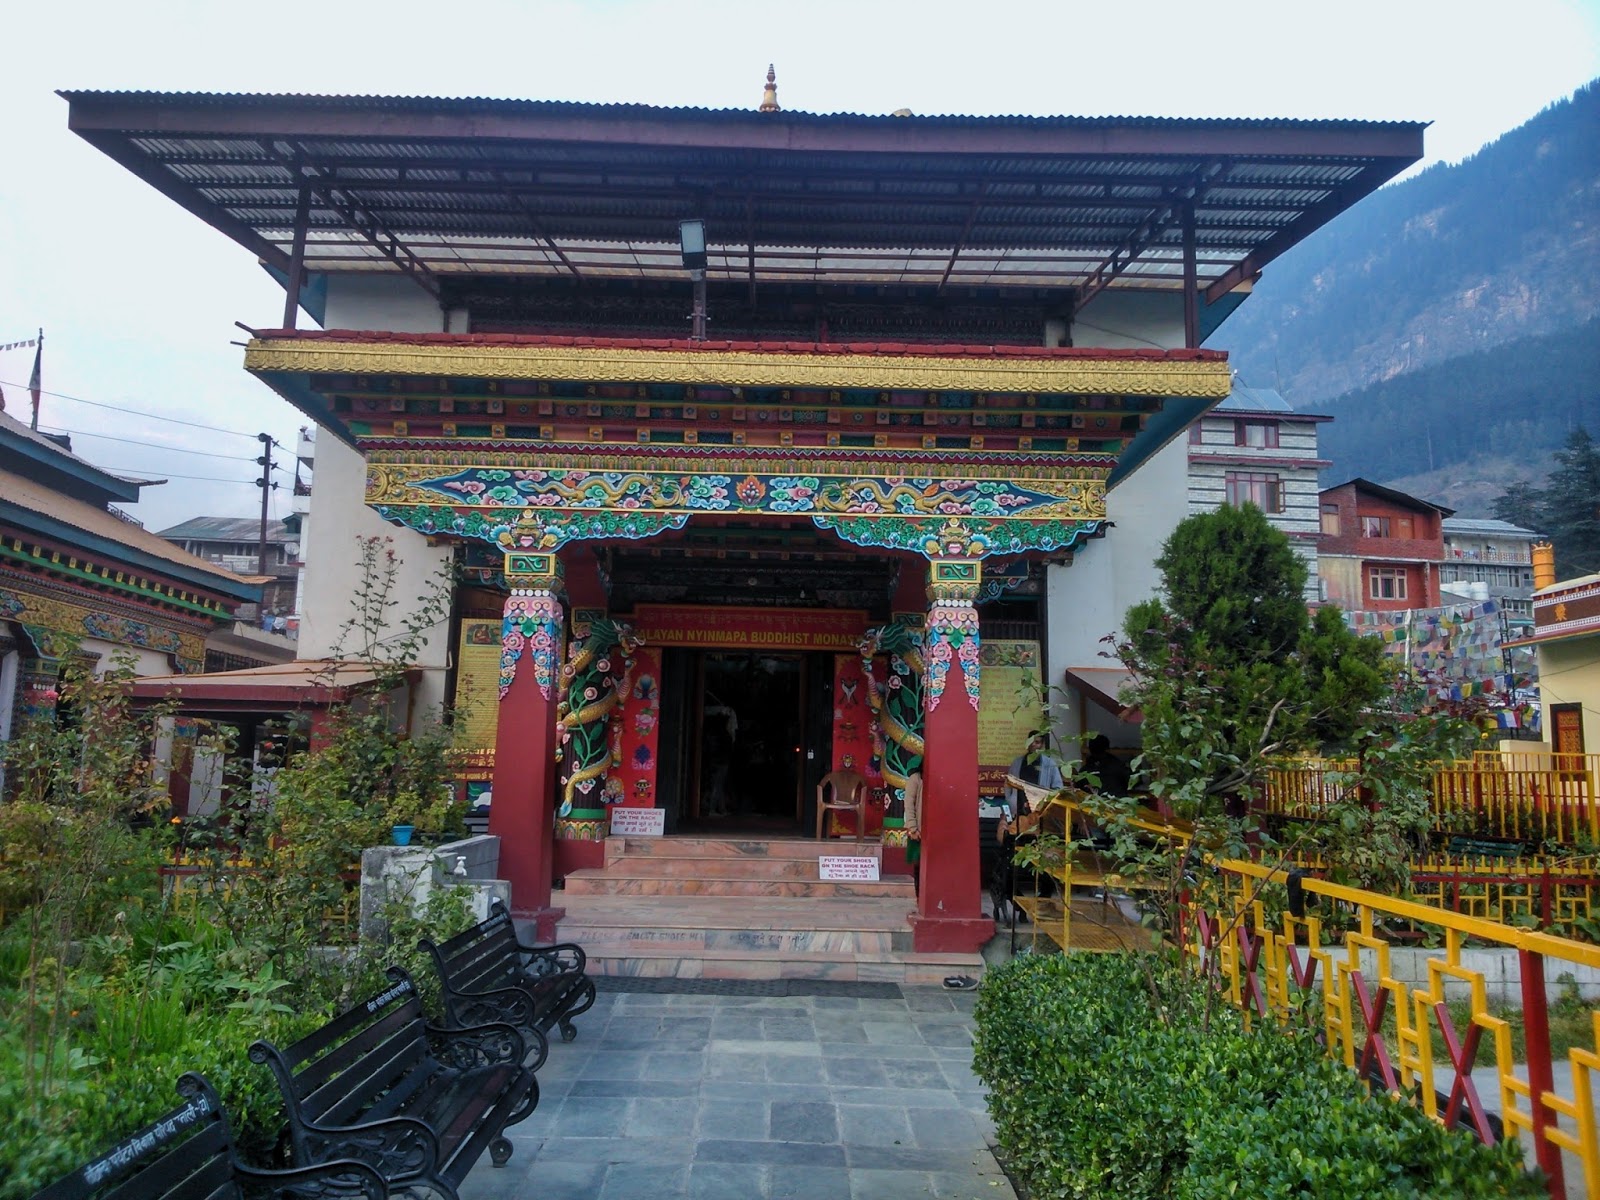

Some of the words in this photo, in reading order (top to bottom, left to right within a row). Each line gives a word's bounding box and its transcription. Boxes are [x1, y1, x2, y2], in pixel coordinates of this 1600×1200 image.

[636, 628, 684, 641] ALAYAN
[687, 629, 748, 643] NYINMAPA
[751, 631, 810, 645] BUDDHIST
[813, 632, 857, 646] MONAS
[580, 931, 614, 940] PLES
